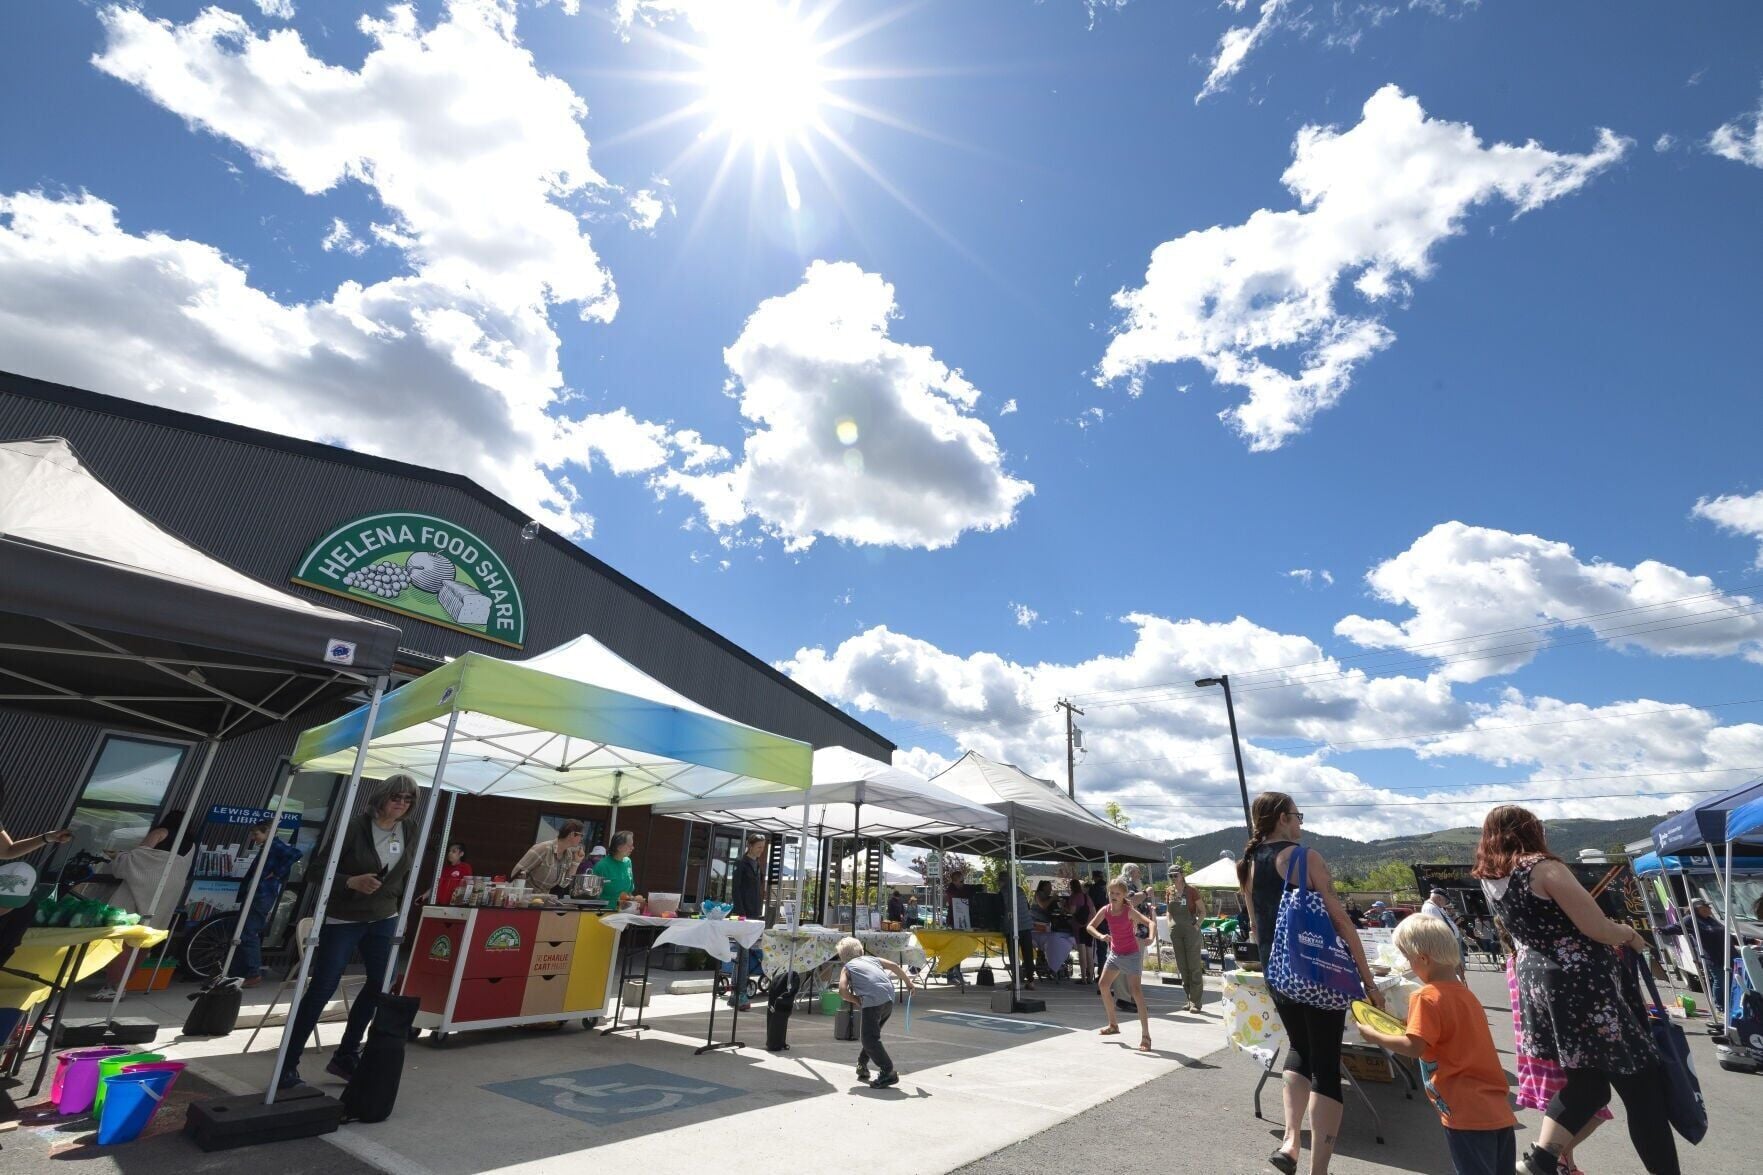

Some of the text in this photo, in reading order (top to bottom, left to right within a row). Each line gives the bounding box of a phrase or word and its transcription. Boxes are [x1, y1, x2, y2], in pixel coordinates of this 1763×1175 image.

[318, 524, 515, 631] HELENA FOOD SHARE
[213, 806, 250, 817] LEWIS
[251, 810, 260, 818] &
[543, 953, 569, 962] CHARLIE
[534, 963, 550, 971] CART
